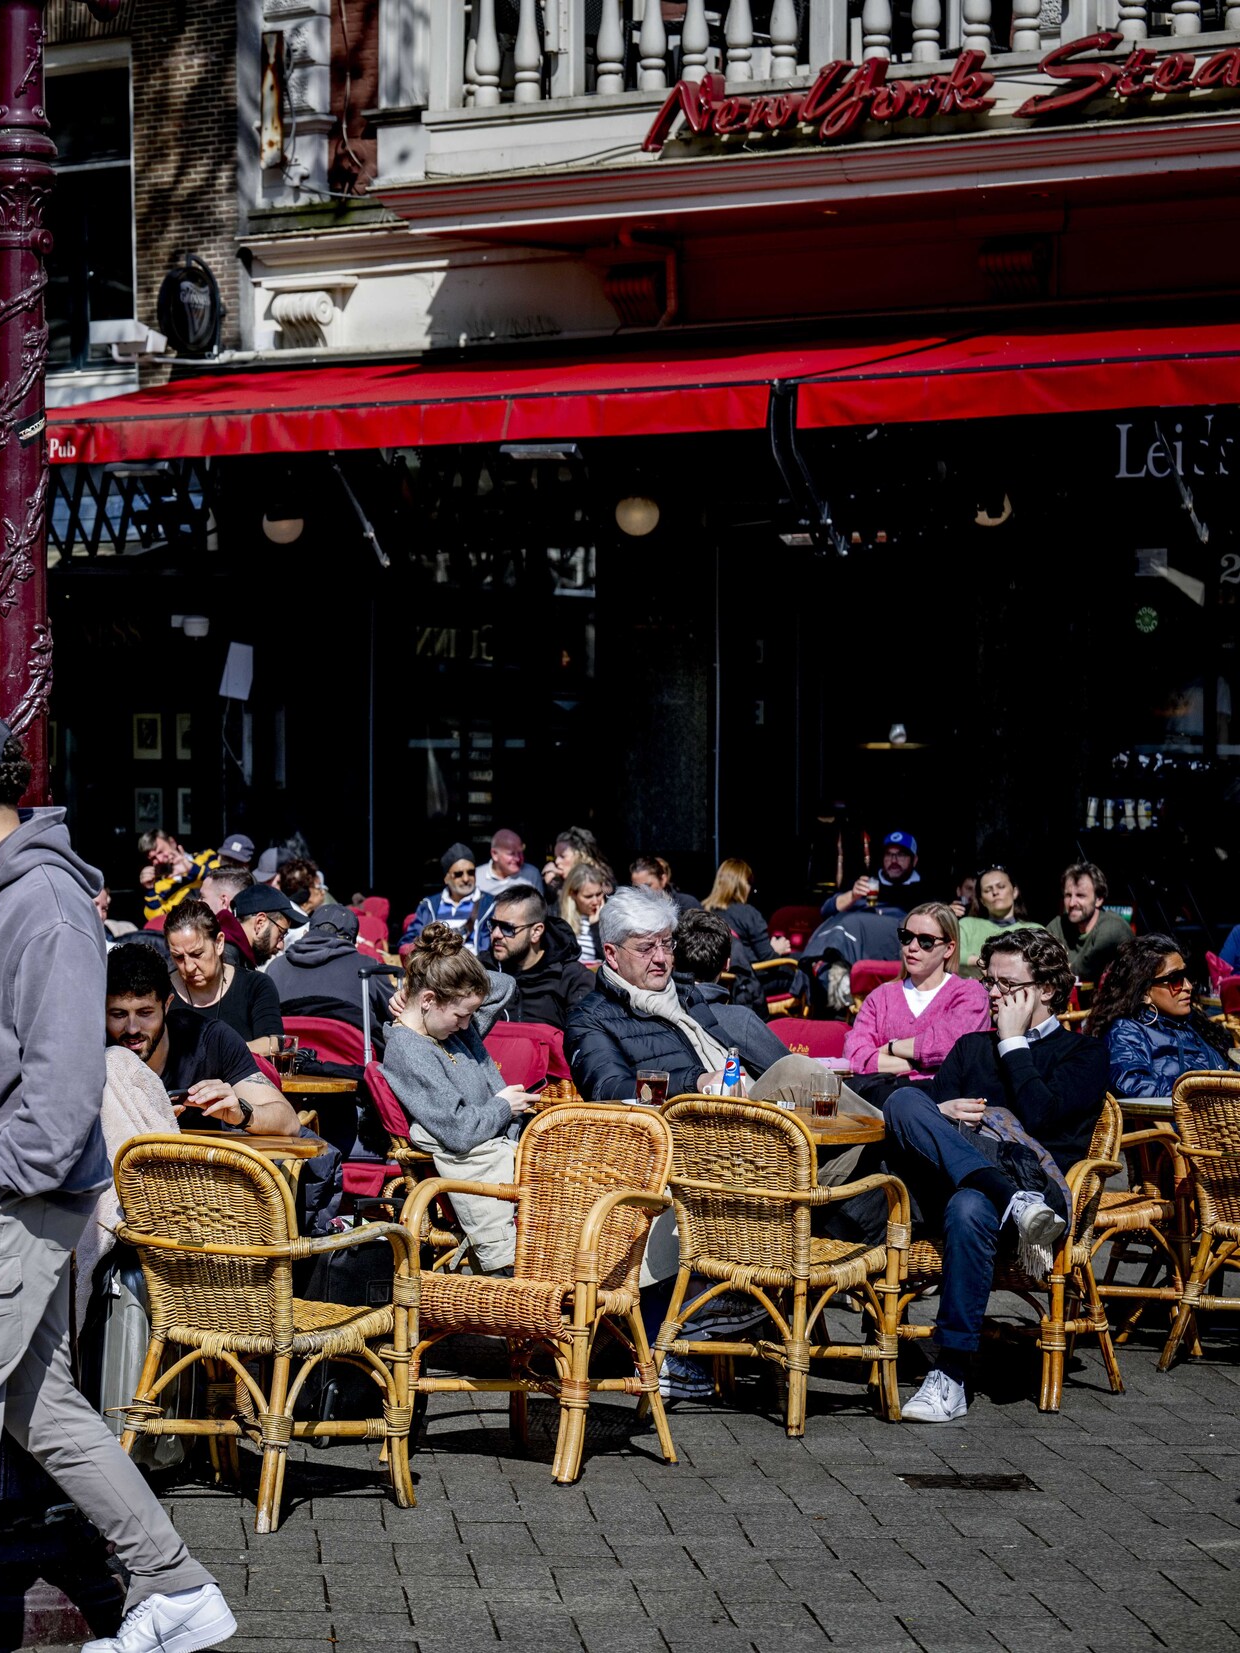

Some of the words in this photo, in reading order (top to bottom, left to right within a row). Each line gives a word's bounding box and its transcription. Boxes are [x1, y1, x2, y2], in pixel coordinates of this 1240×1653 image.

[641, 72, 800, 153] New
[796, 48, 997, 141] York
[49, 438, 76, 458] Pub
[797, 1043, 809, 1053] Pub
